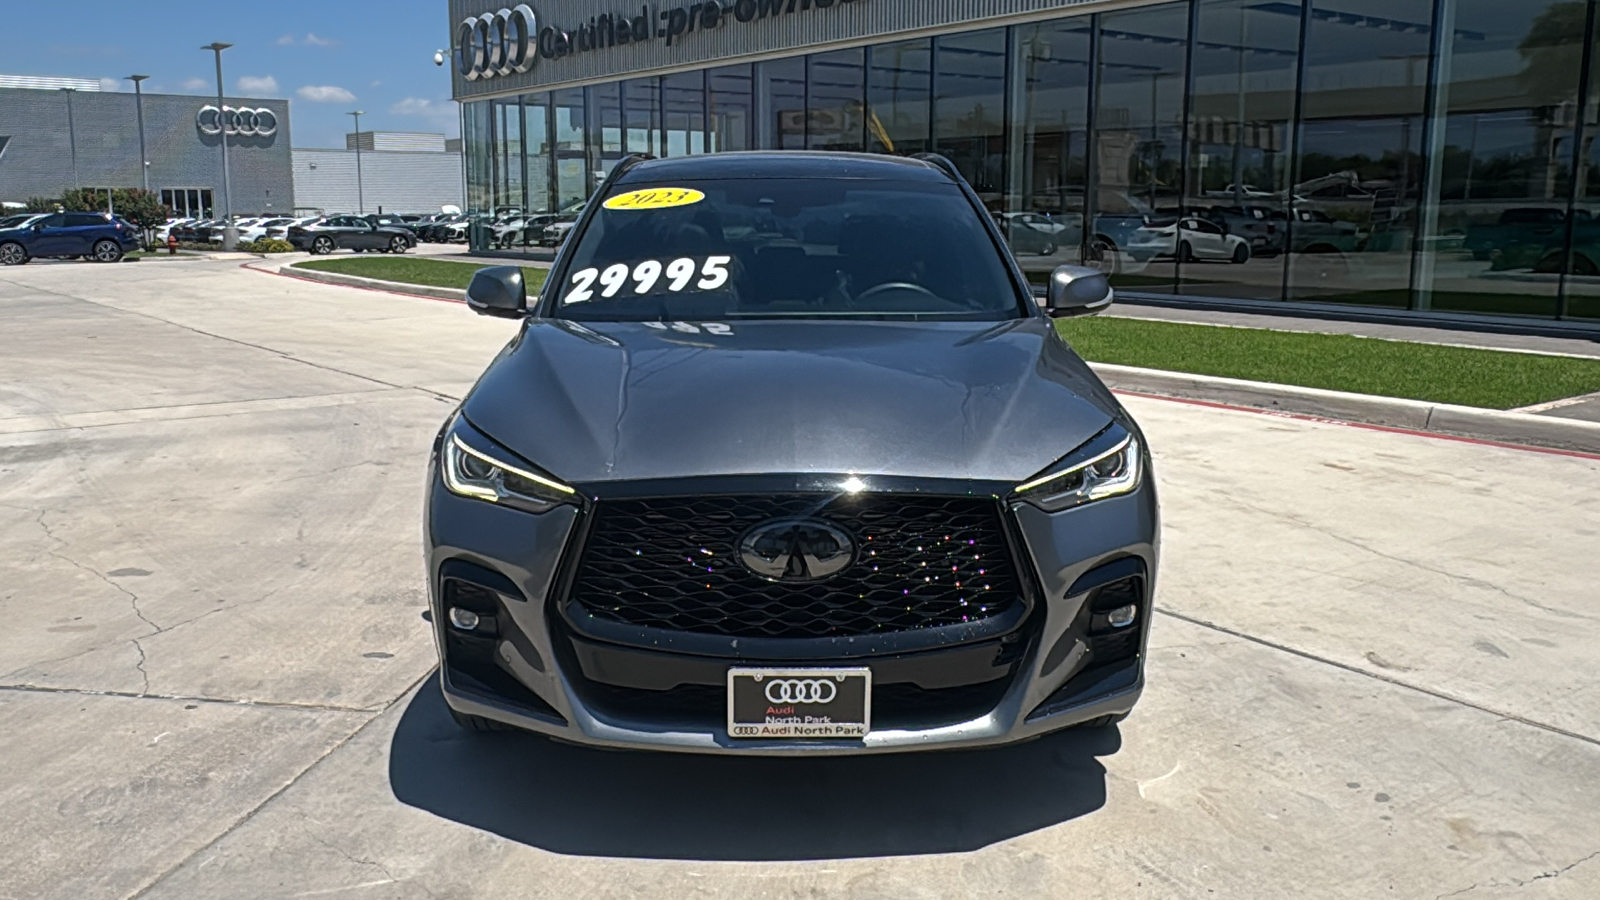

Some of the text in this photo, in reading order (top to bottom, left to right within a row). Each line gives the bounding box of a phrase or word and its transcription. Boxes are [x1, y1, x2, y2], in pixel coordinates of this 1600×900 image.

[539, 5, 649, 59] Certified
[618, 191, 690, 206] 2023
[564, 255, 731, 304] 29995
[766, 706, 795, 714] Audi
[765, 715, 831, 724] North Park
[761, 726, 864, 735] Audi North Park
